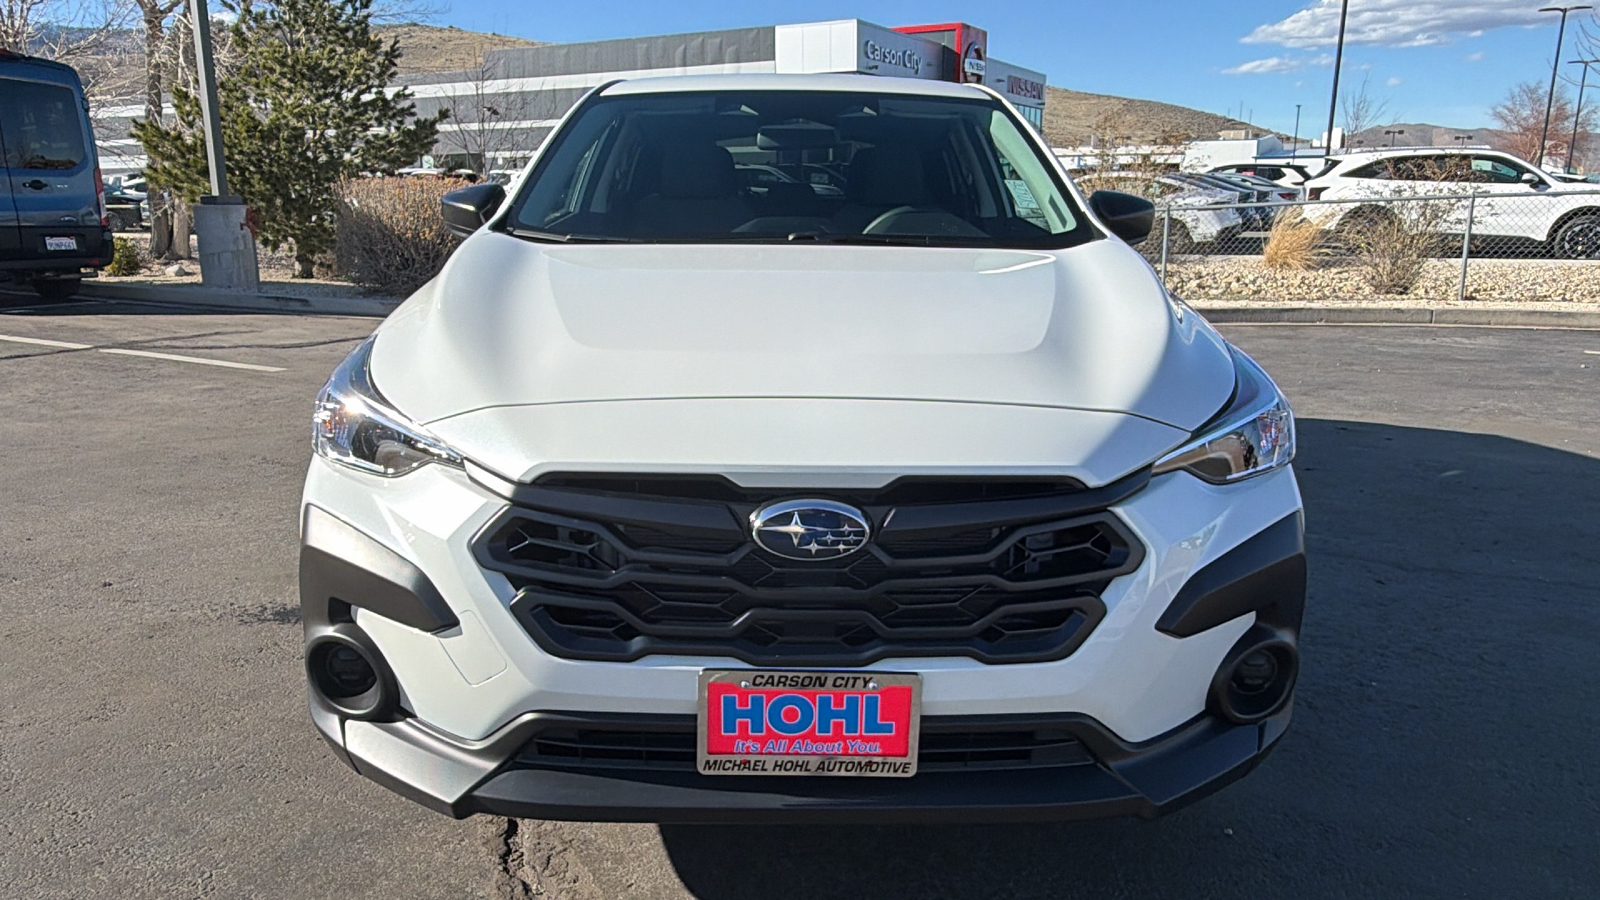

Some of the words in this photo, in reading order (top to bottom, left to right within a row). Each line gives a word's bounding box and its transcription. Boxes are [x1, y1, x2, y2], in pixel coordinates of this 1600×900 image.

[866, 40, 903, 66] Carson
[904, 50, 922, 73] City
[1007, 75, 1044, 100] NISSAN
[751, 674, 828, 688] CARSON
[832, 676, 873, 689] CITY
[721, 694, 895, 735] HOHL
[734, 738, 760, 753] It's
[763, 738, 788, 753] All
[789, 739, 842, 753] About
[847, 739, 881, 753] You.
[703, 759, 768, 772] MICHAEL
[772, 759, 811, 772] HOHL
[815, 760, 911, 774] AUTOMOTIVE
